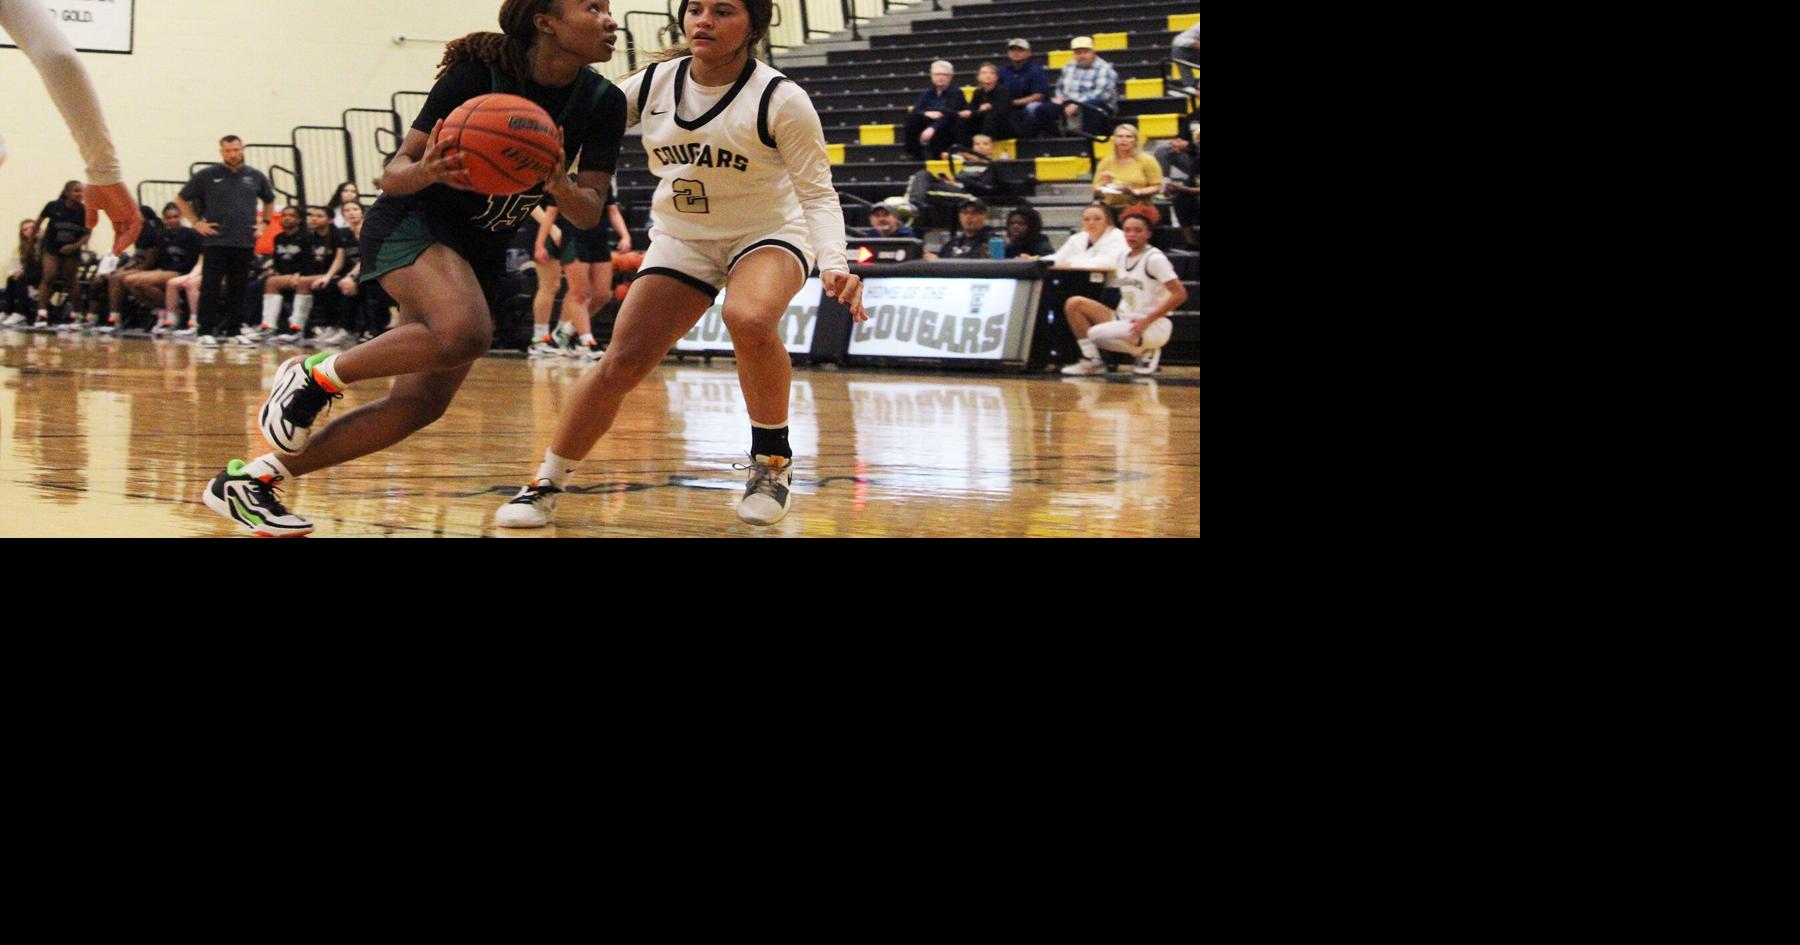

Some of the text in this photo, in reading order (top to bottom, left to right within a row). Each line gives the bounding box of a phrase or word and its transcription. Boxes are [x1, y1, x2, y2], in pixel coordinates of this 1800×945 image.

[653, 142, 749, 172] COUGARS
[672, 178, 709, 213] 2
[854, 304, 1006, 353] COUGARS
